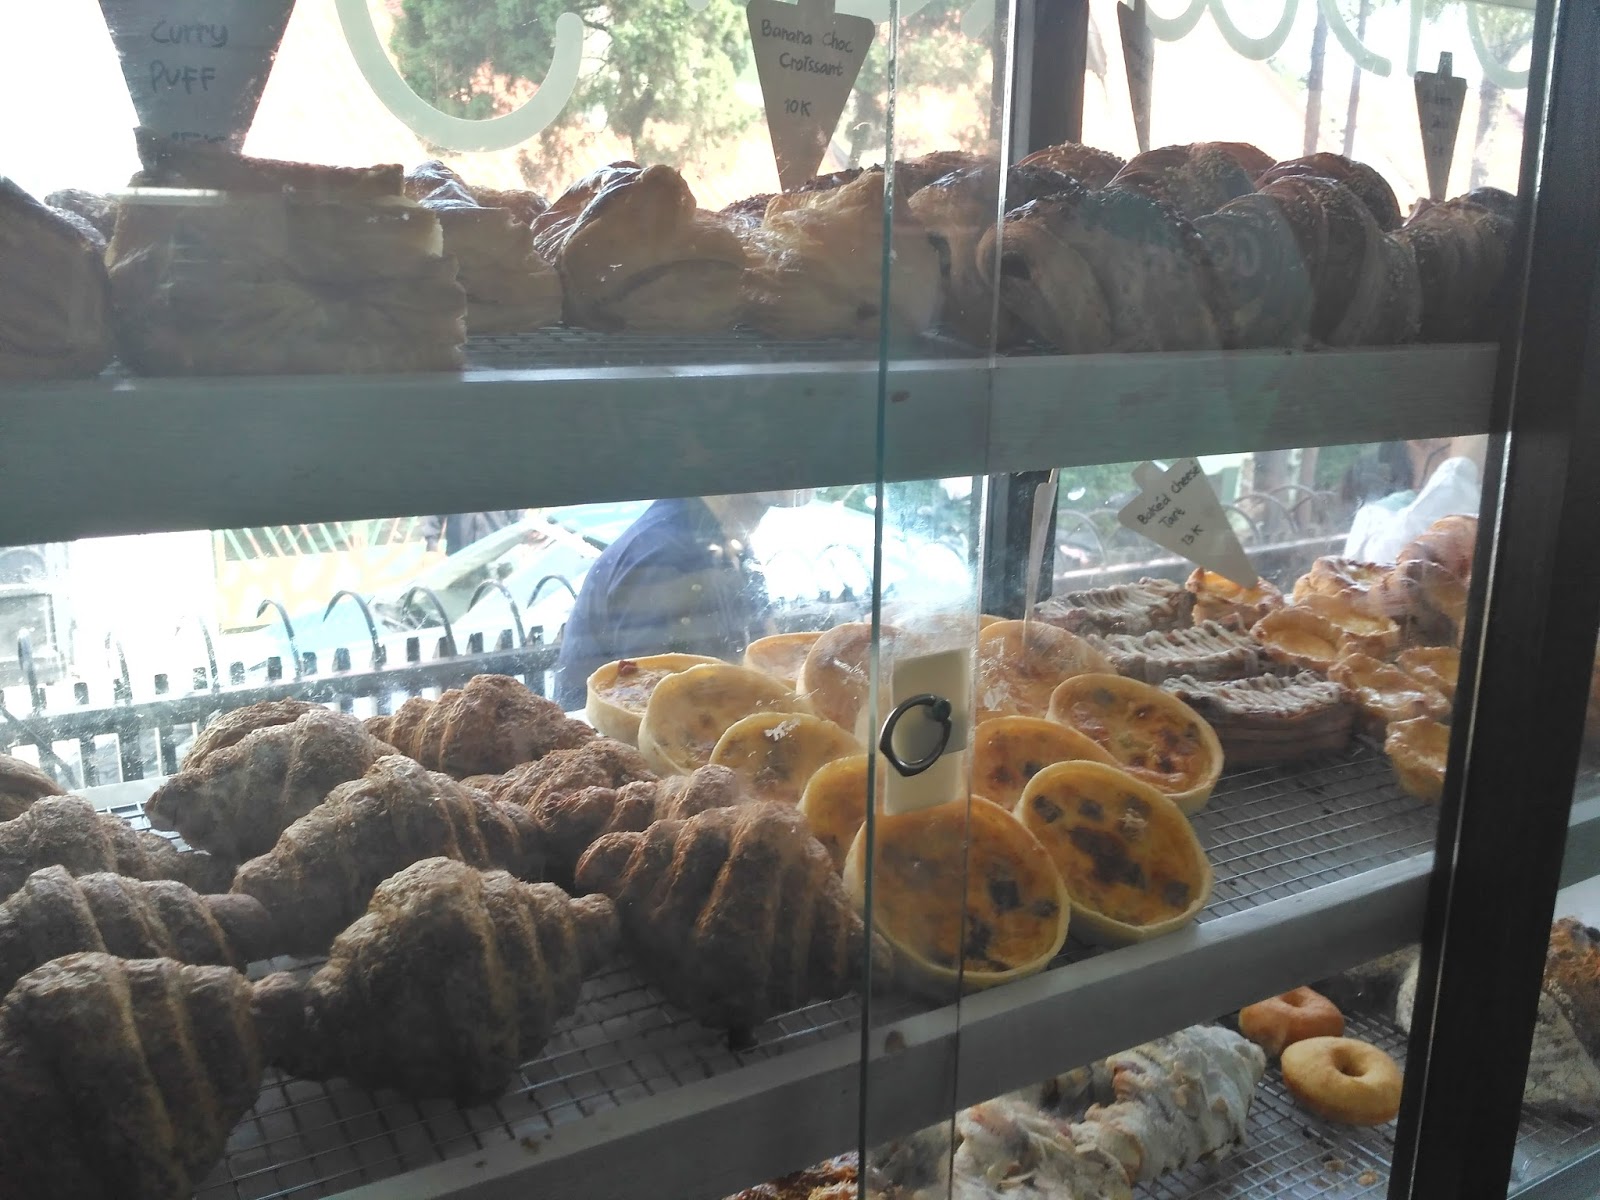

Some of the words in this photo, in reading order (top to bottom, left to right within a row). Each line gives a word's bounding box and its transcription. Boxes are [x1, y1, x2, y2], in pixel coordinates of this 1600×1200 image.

[151, 19, 228, 48] Curry
[761, 18, 813, 46] Banana
[778, 51, 844, 77] Croissant
[784, 98, 812, 117] 10K
[1158, 507, 1186, 528] Tart
